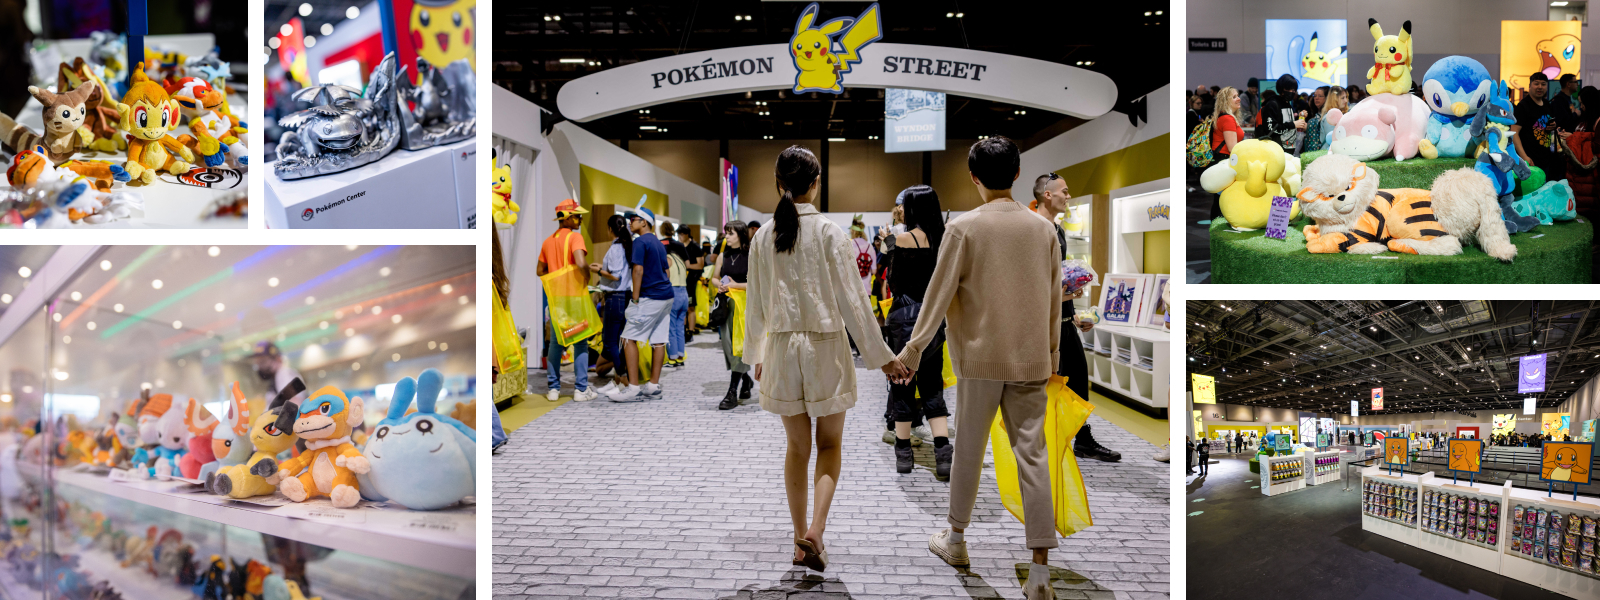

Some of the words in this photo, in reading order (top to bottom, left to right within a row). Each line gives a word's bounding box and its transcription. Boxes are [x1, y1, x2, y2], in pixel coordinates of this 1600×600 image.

[651, 56, 774, 89] POKÉMON
[882, 55, 987, 81] STREET
[894, 123, 936, 133] WYNDON
[897, 134, 934, 143] BRIDGE
[315, 198, 346, 214] Pokémon
[346, 190, 367, 202] Center
